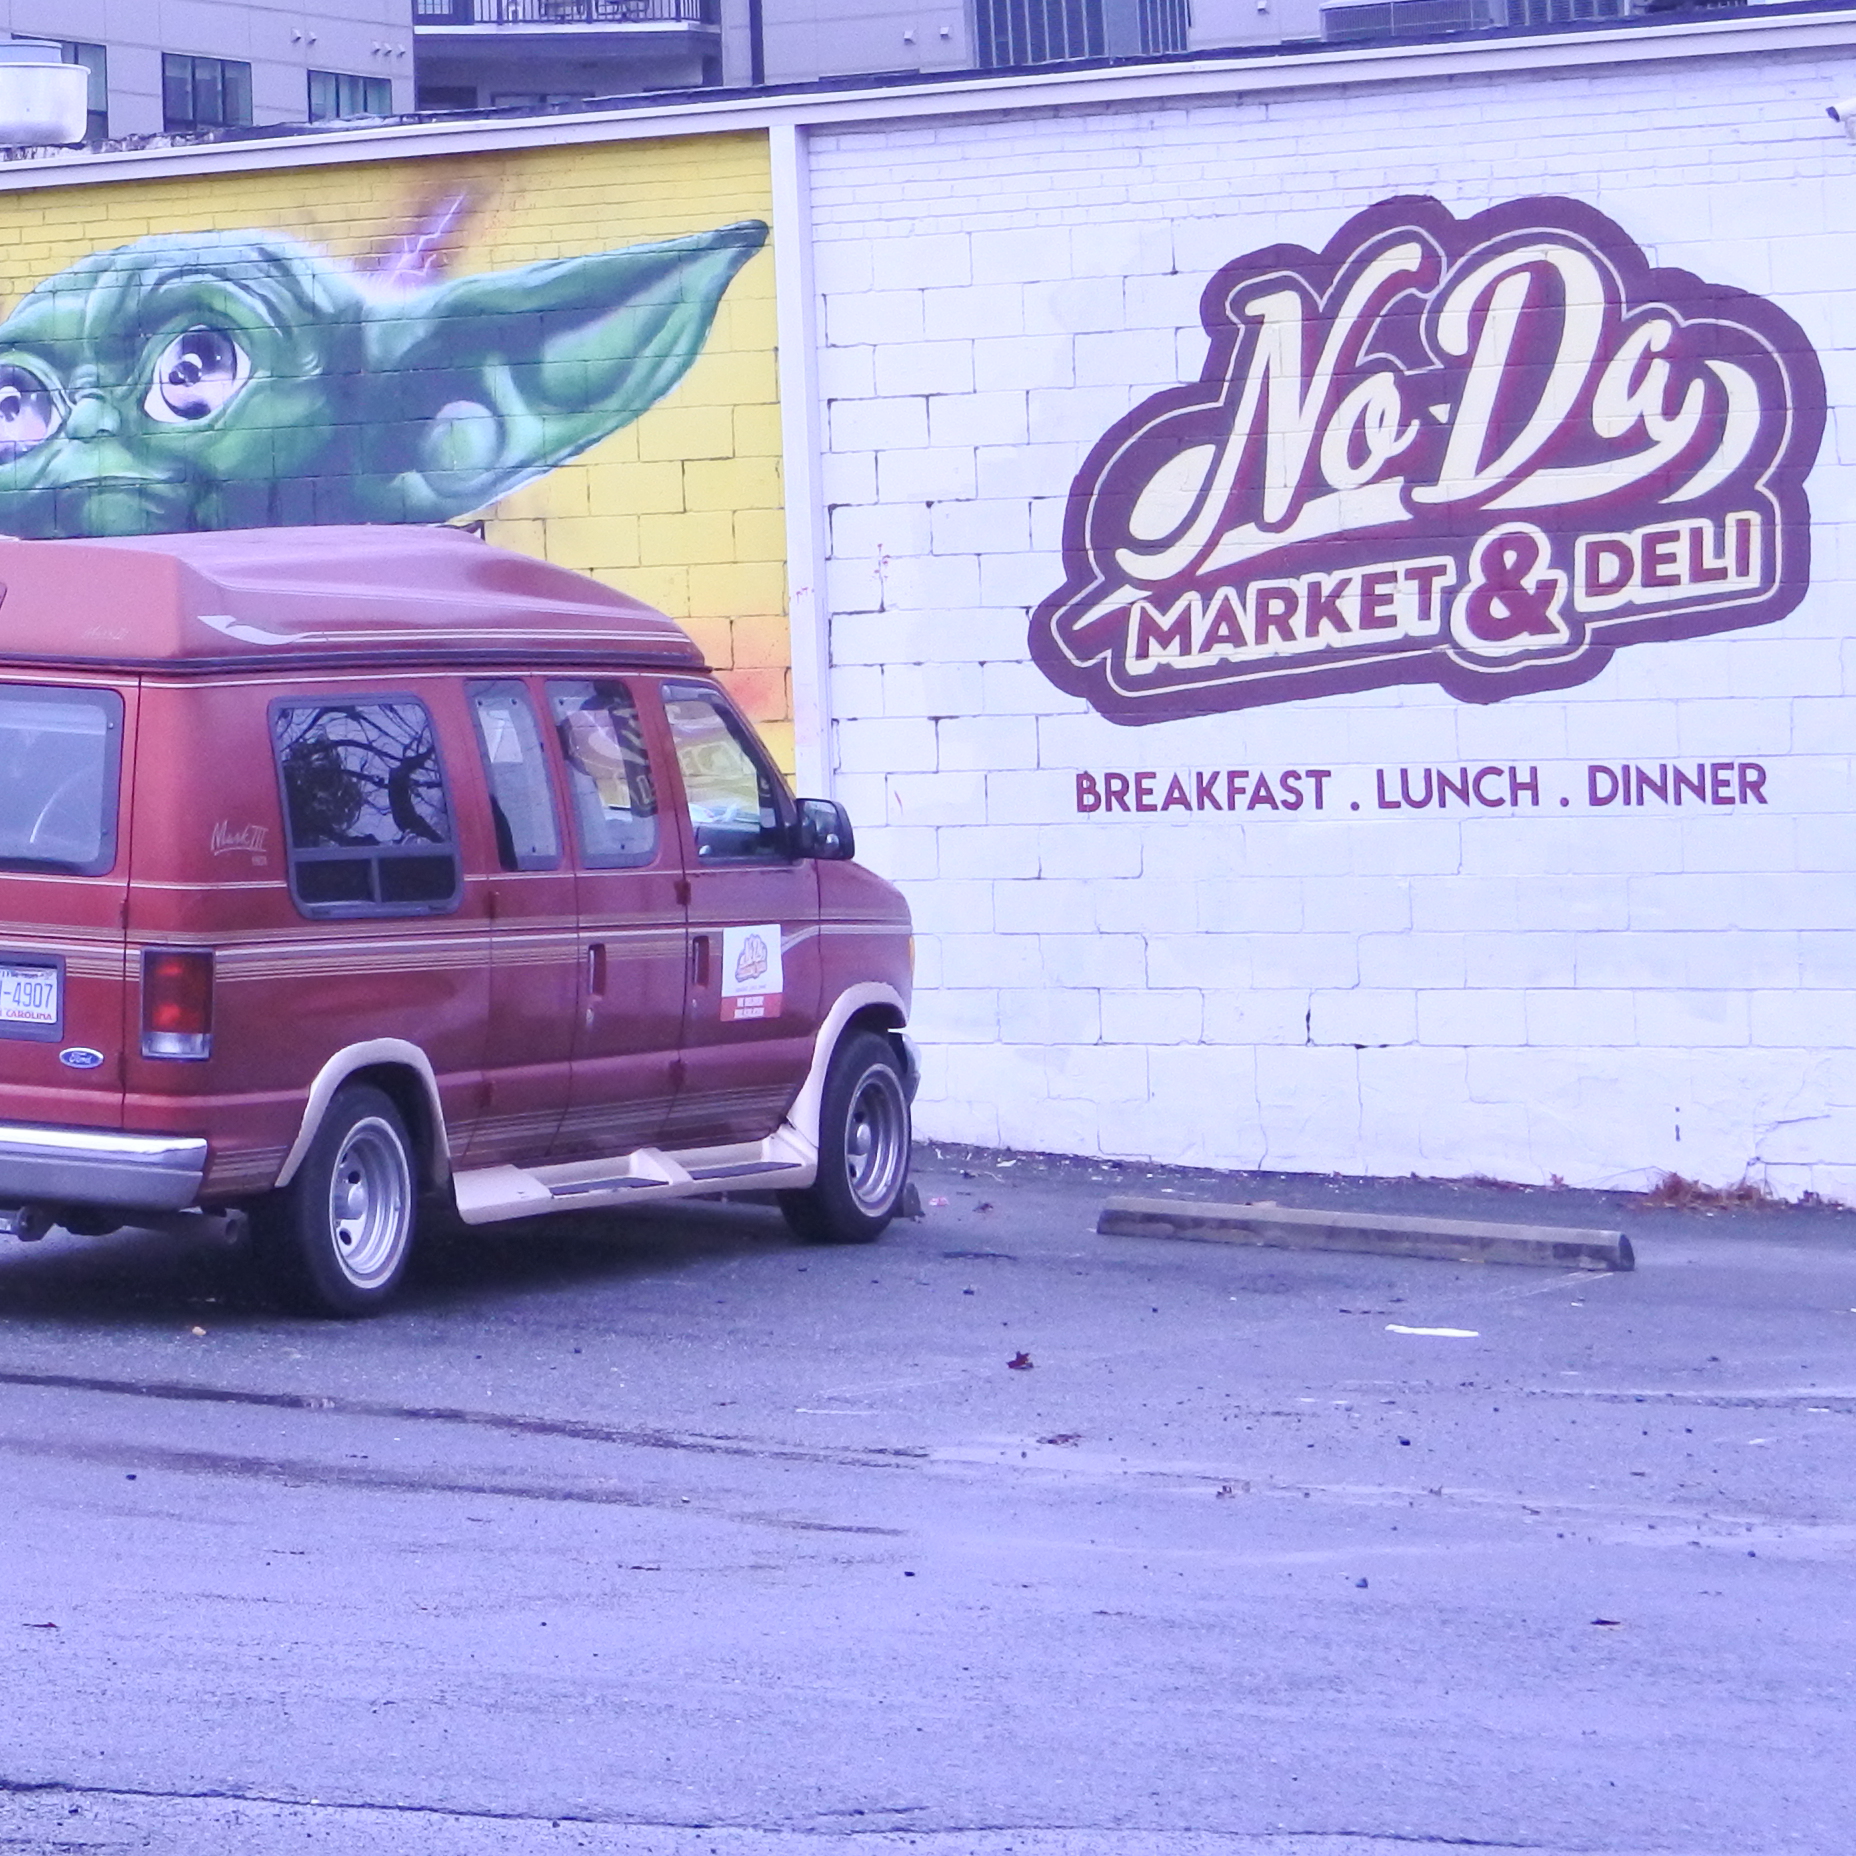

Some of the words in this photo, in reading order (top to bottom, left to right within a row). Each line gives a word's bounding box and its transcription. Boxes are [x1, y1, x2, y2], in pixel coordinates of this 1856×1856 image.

[1131, 559, 1454, 666] MARKET
[1464, 528, 1564, 649] &
[1583, 516, 1756, 602] DELI
[1076, 769, 1331, 813] BREAKFAST
[1376, 766, 1540, 809] LUNCH
[1589, 762, 1768, 808] DINNER
